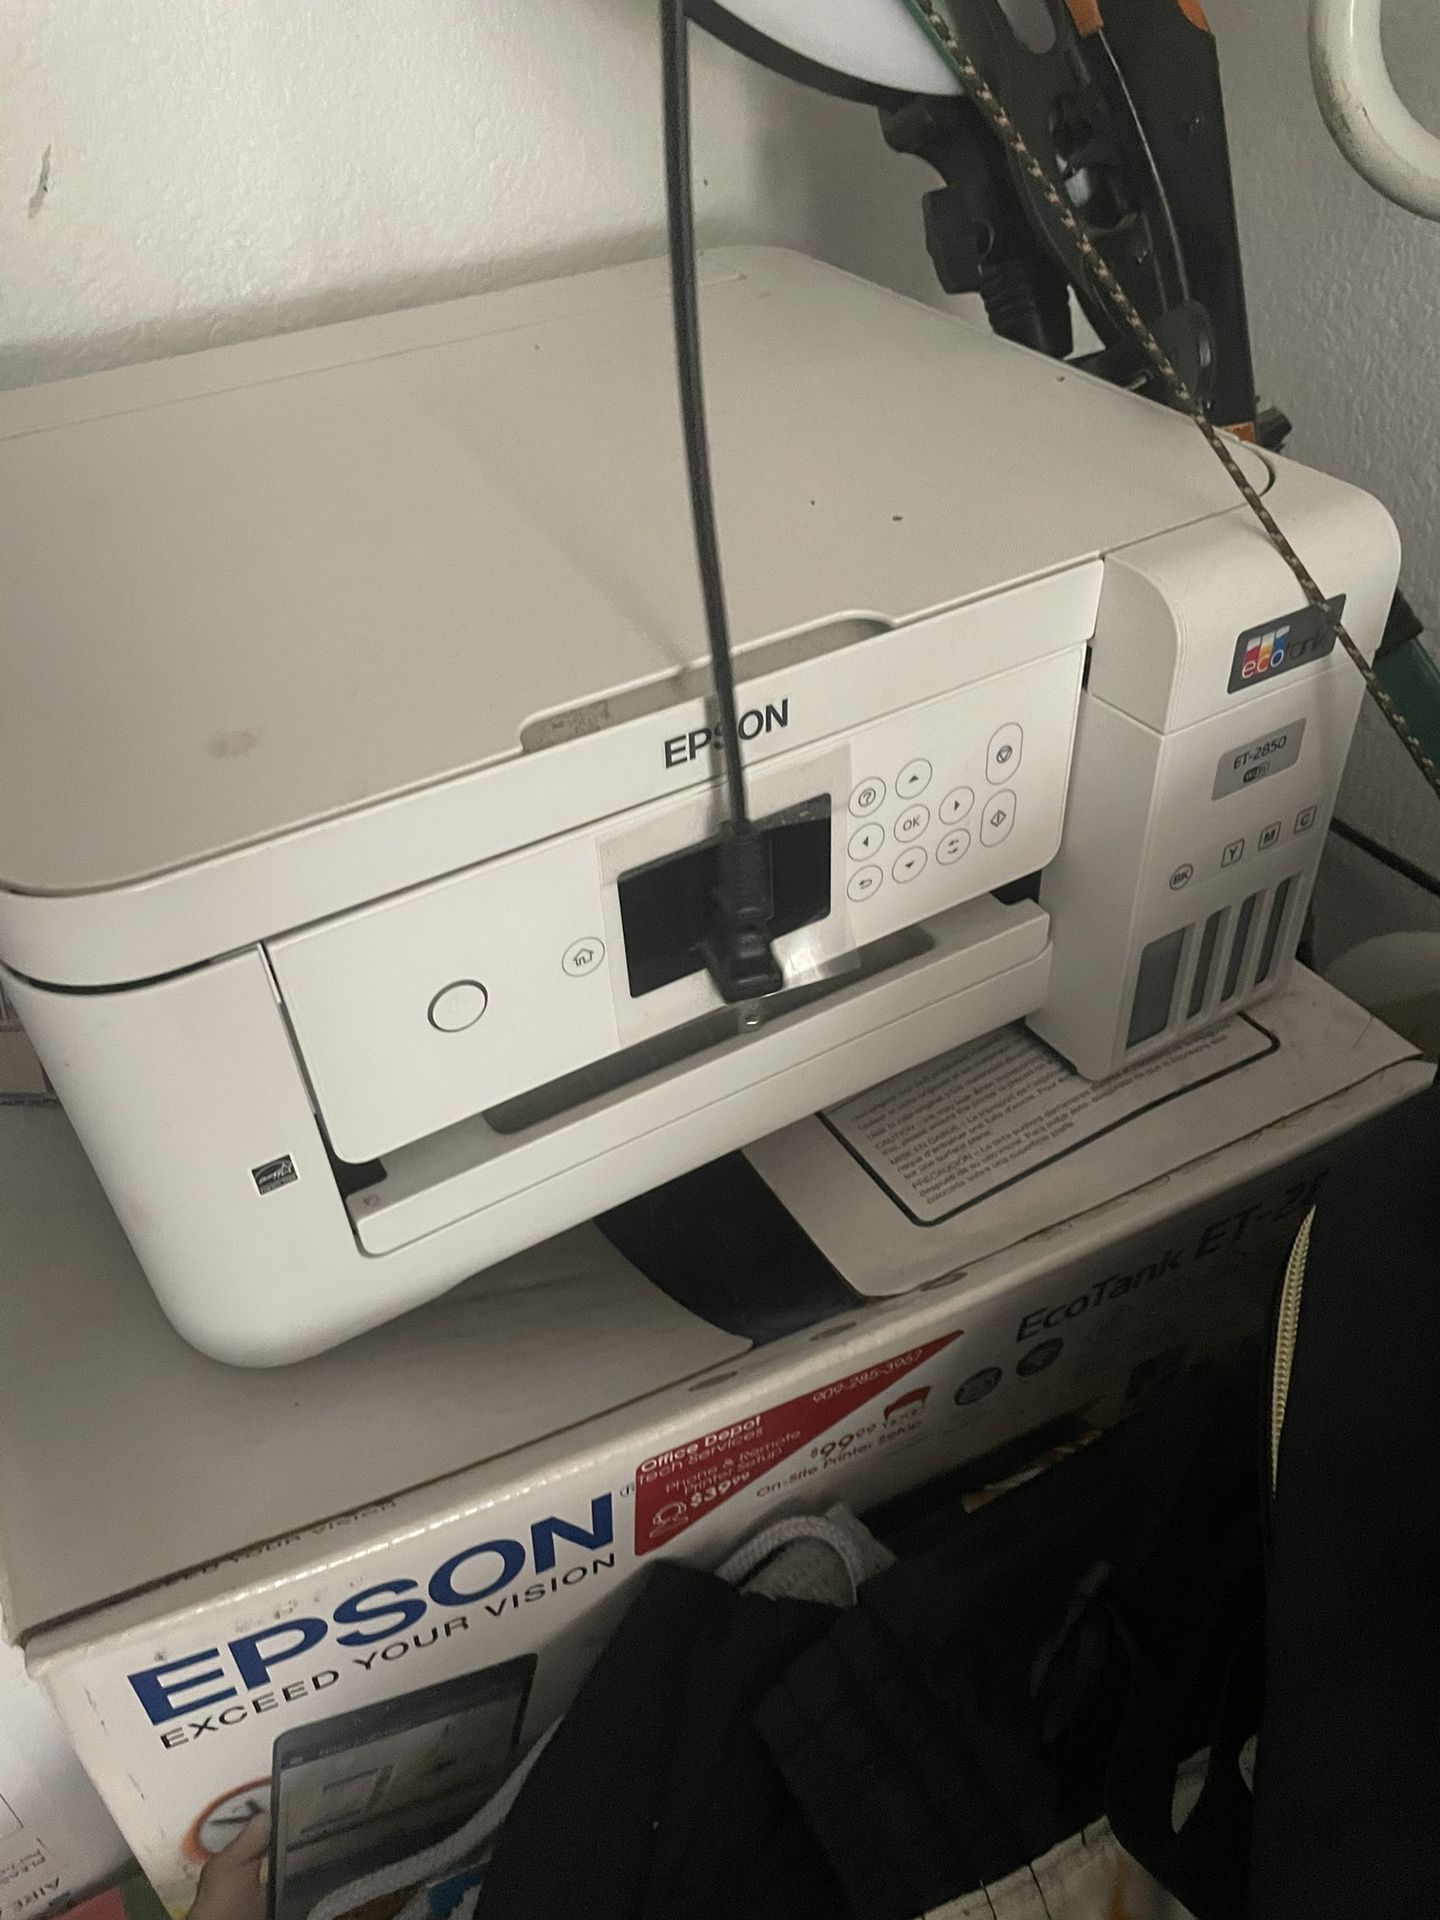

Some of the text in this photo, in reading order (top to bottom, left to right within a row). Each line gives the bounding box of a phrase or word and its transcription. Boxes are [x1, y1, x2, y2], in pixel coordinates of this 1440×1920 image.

[664, 698, 788, 769] EPON
[1233, 735, 1287, 770] ET-2850
[903, 815, 920, 831] OK
[1016, 1248, 1184, 1342] EcoTank
[641, 1415, 761, 1473] Office Depot
[127, 1493, 613, 1725] EPSON
[160, 1669, 340, 1749] EXCEED
[353, 1616, 470, 1672] YOUR
[485, 1553, 617, 1619] VISION
